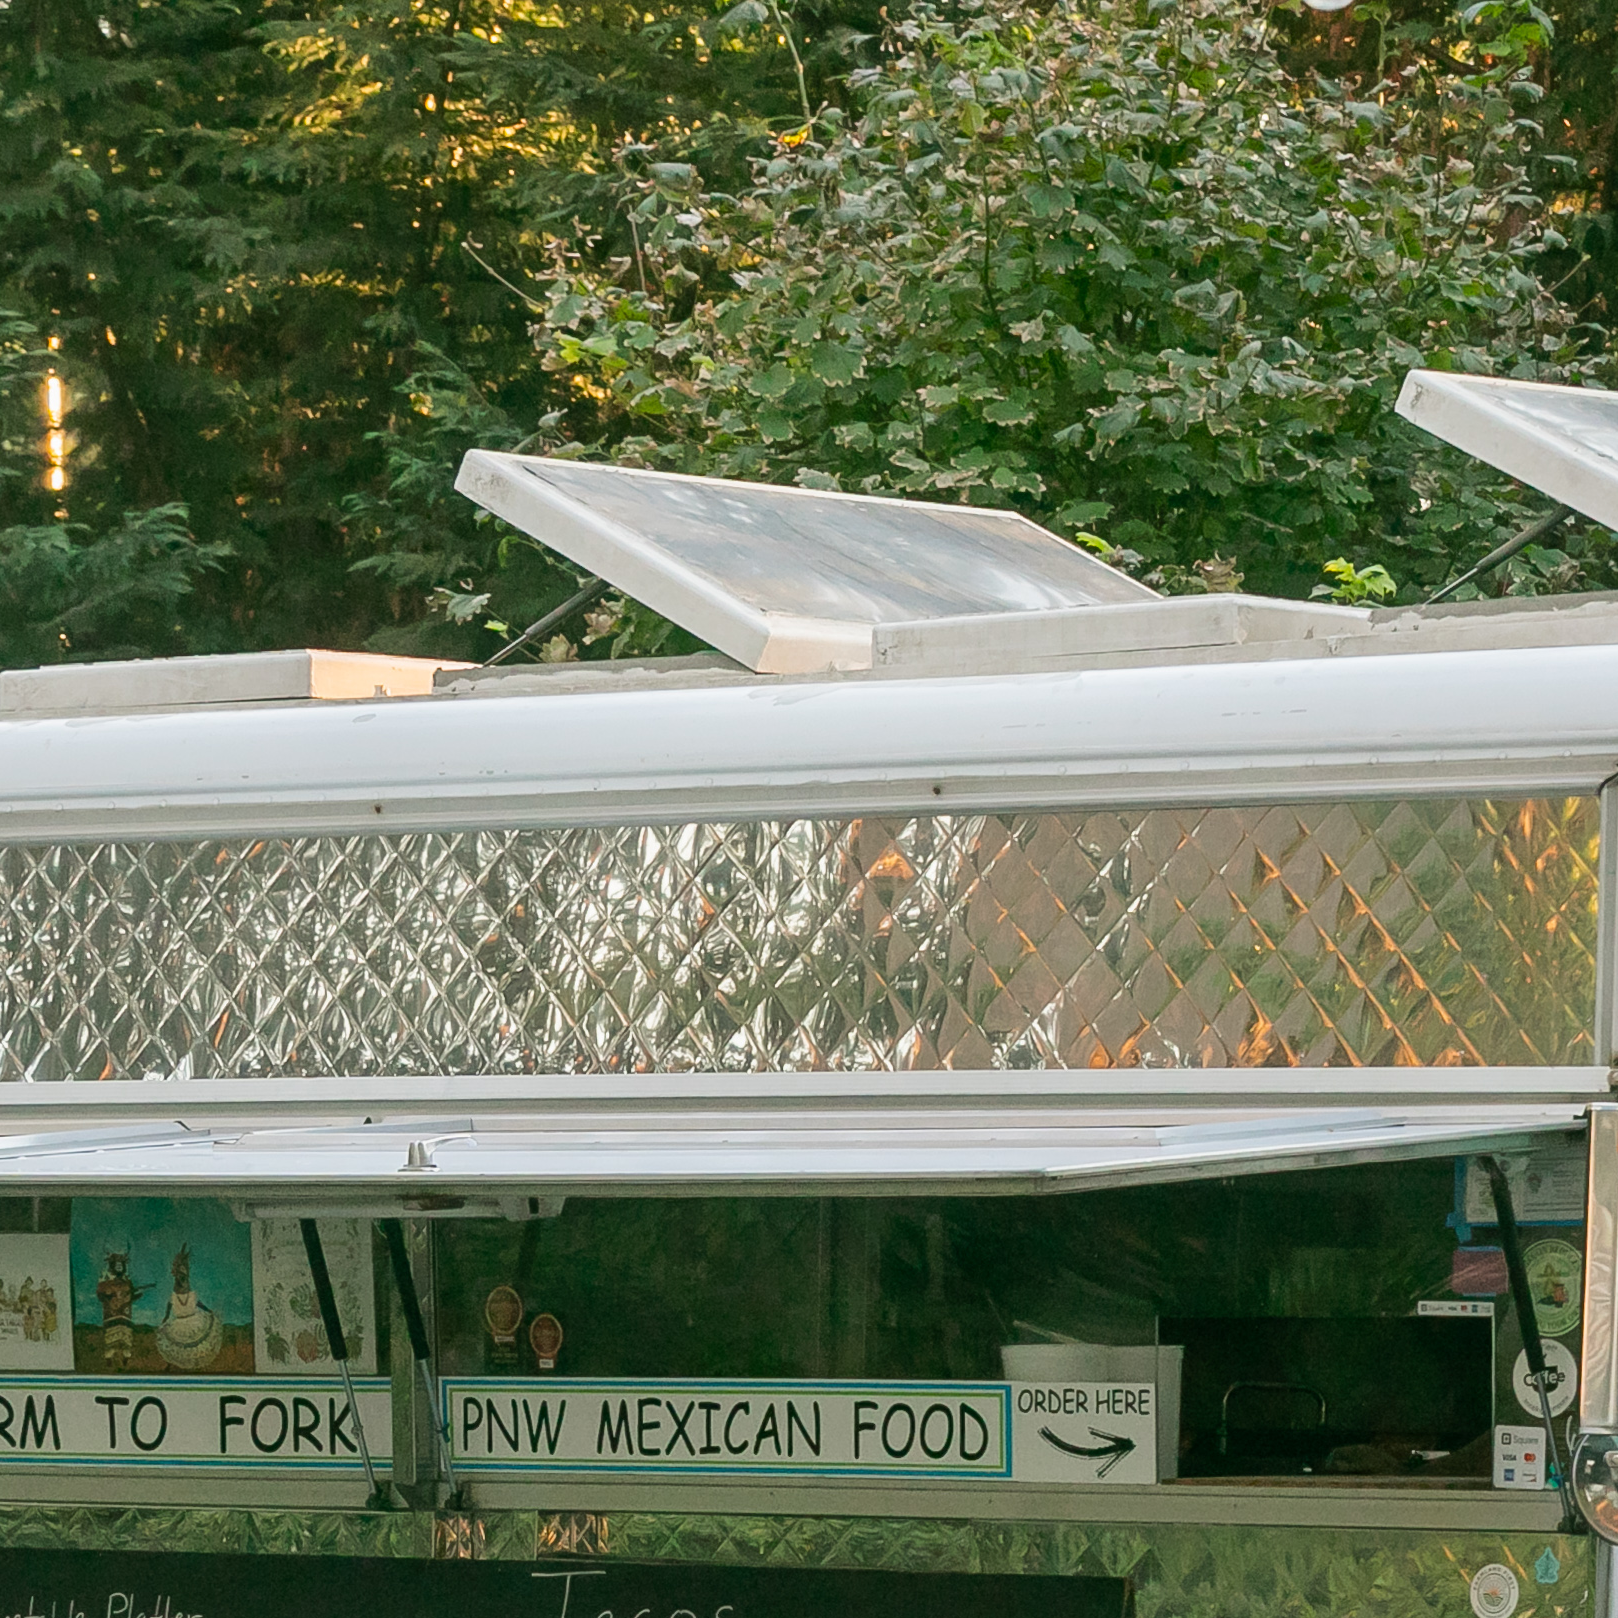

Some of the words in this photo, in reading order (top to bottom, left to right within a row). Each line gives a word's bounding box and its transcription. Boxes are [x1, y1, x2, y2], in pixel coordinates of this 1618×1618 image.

[94, 1395, 168, 1453] TO
[219, 1396, 360, 1456] FORK
[462, 1397, 568, 1455] PNW
[596, 1397, 823, 1458] MEXICAN
[853, 1400, 990, 1462] FOOD
[1017, 1388, 1089, 1416] ORDER
[1094, 1389, 1151, 1416] HERE
